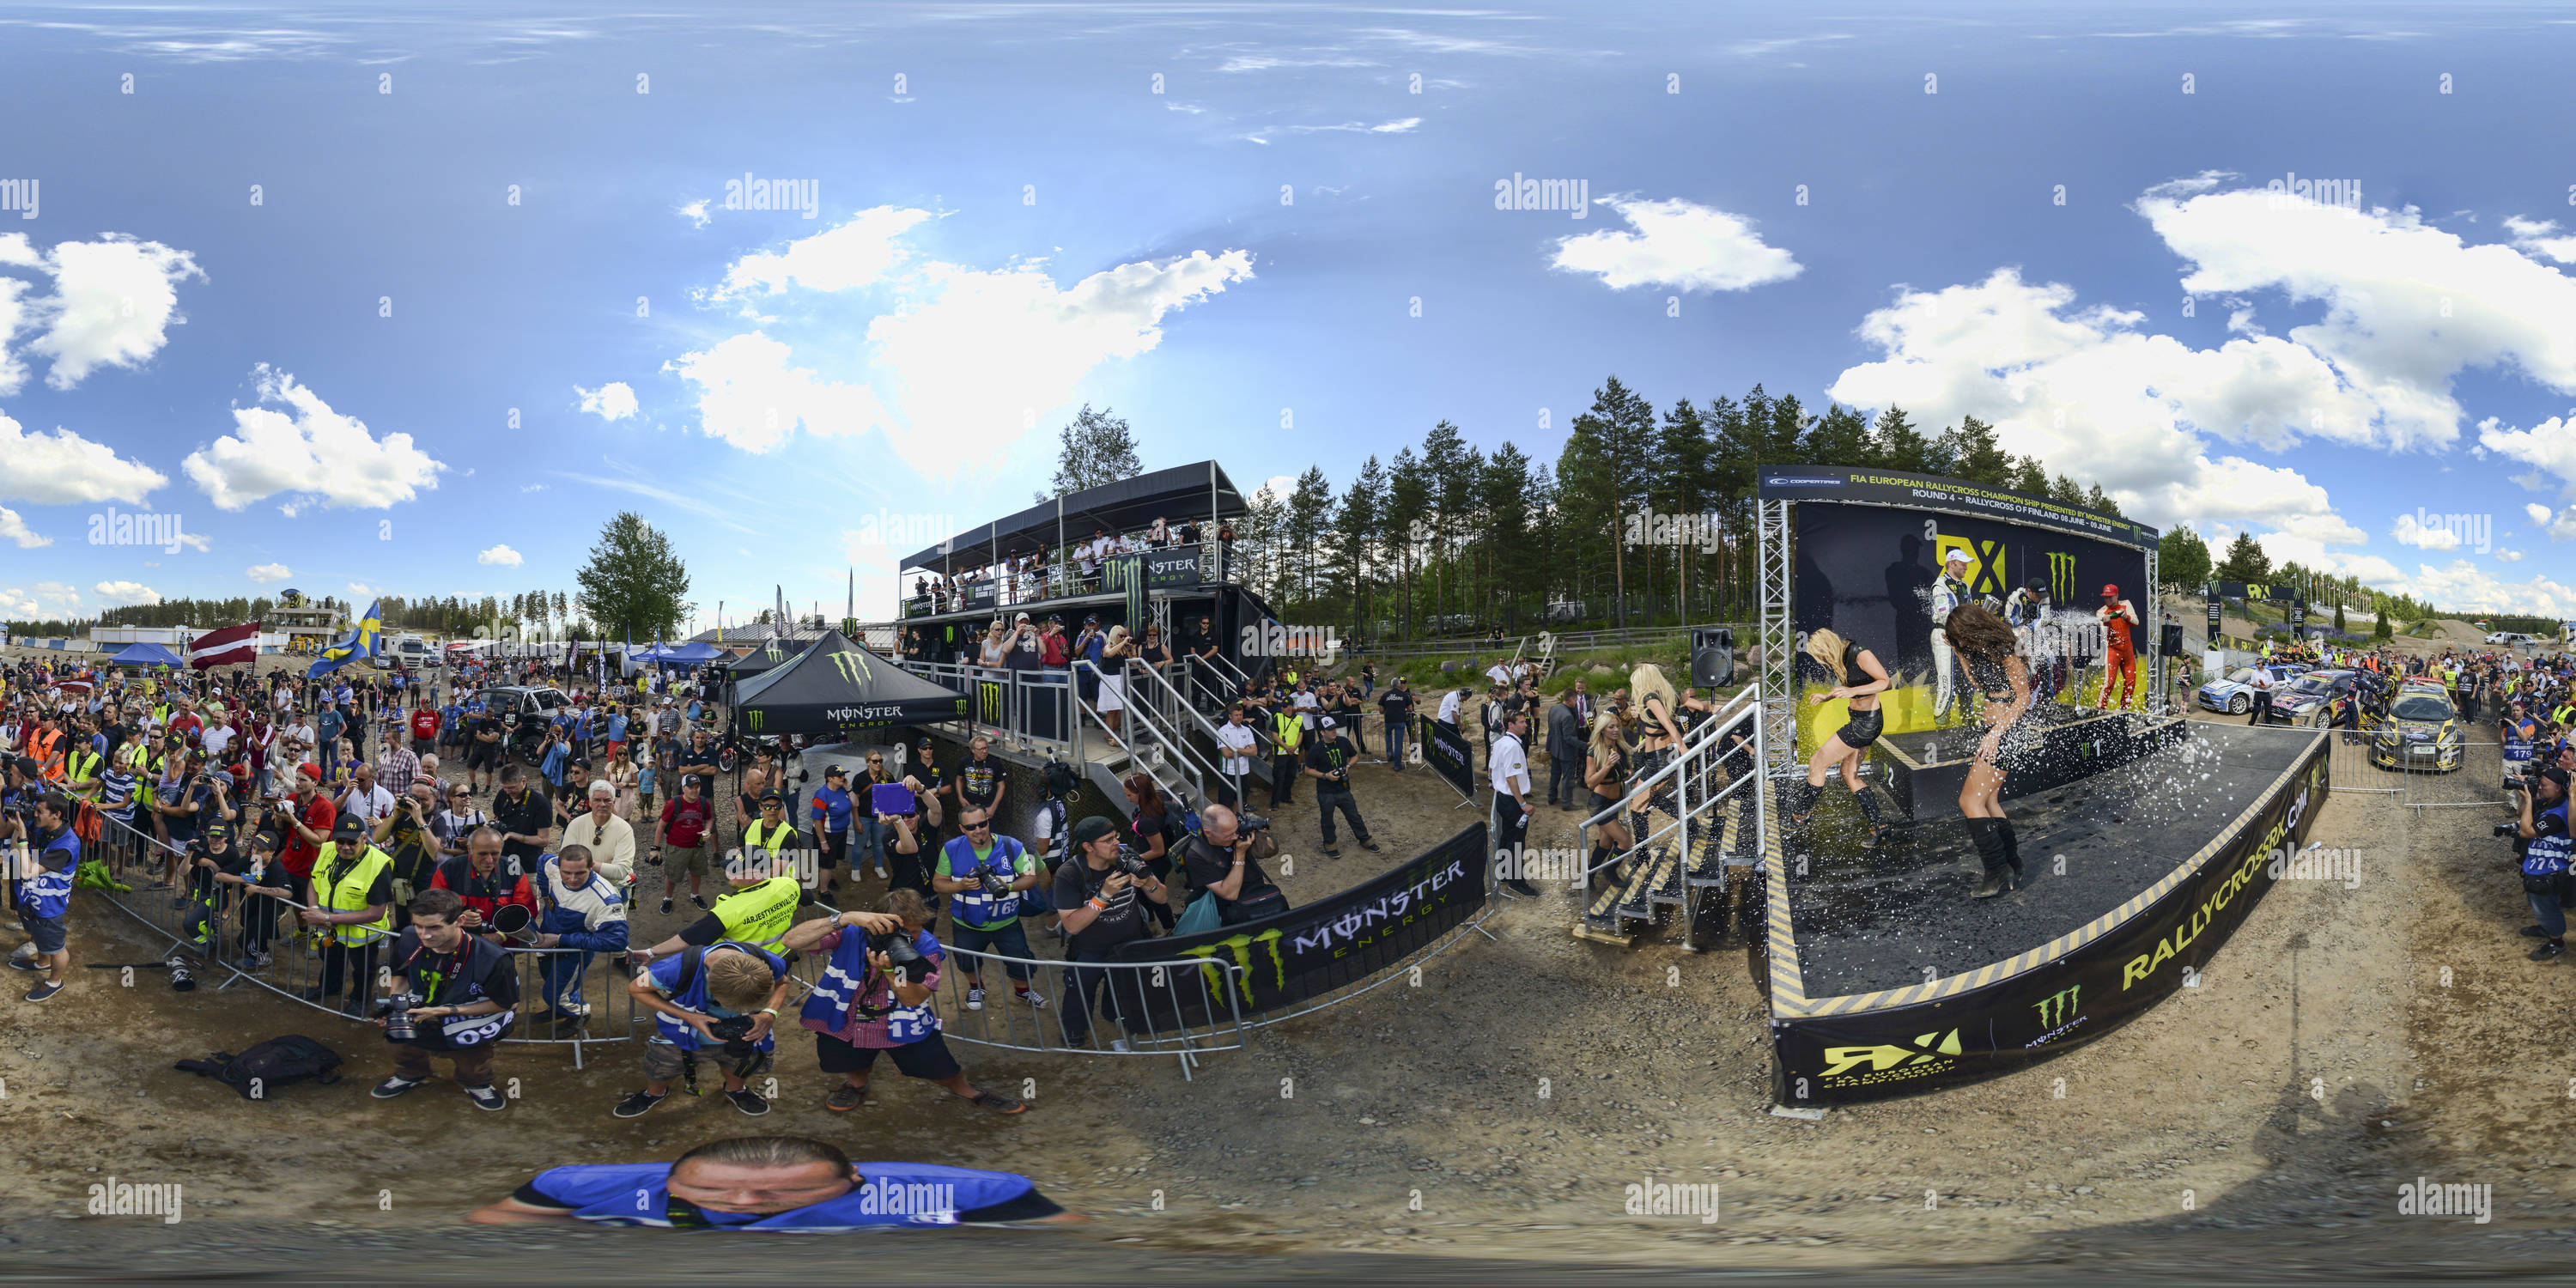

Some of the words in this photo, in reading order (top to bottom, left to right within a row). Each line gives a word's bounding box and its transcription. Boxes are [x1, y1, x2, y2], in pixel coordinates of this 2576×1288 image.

[1850, 474, 1867, 483] FIA
[1869, 476, 1923, 489] EUROPEAN
[1926, 481, 1979, 497] RALLYCROSS
[2041, 502, 2076, 517] PRESENTED
[2086, 513, 2111, 526] MONSTER
[2111, 519, 2131, 531] ENERGY
[1912, 489, 1947, 501] ROUND
[1949, 491, 1955, 501] 4
[1965, 495, 2014, 511] RALLYCROSS
[2027, 507, 2059, 520] FINLAND
[2069, 516, 2085, 526] JUNE
[2098, 523, 2112, 532] JUNE
[1149, 558, 1196, 574] NSTER
[1151, 574, 1185, 583] ERGY
[910, 601, 933, 611] MONSTER
[827, 705, 903, 721] MONSTER
[839, 720, 894, 729] ENERGY
[2093, 738, 2101, 756] 1
[2513, 750, 2532, 758] 179
[2529, 857, 2559, 872] 174
[1293, 860, 1466, 955] MONSTER
[1334, 892, 1449, 958] ENERGY
[2026, 1015, 2088, 1048] MONSTER
[1823, 1066, 1956, 1089] CHAMPIONSHIP
[1837, 1066, 1944, 1084] RALLYCROSS
[1863, 1059, 1953, 1078] EUROPEAN
